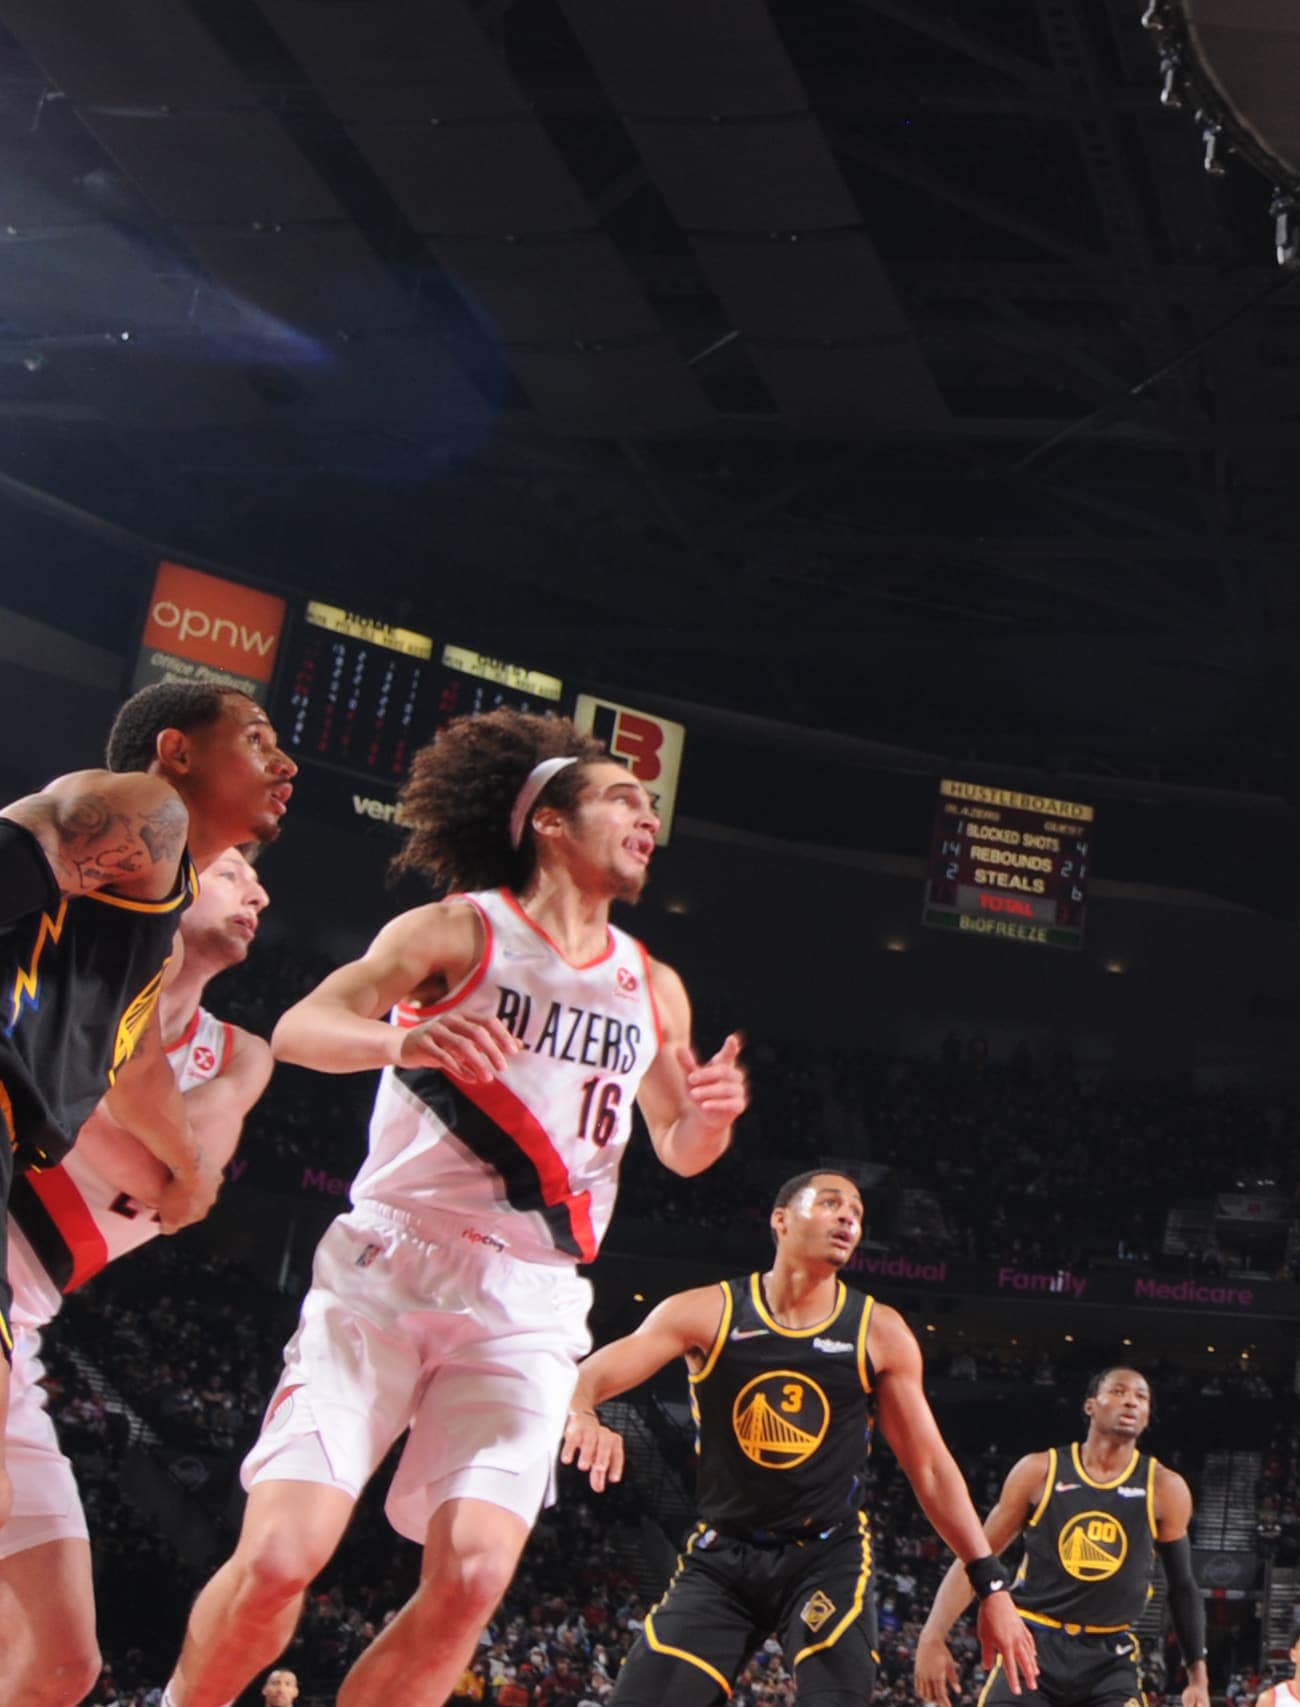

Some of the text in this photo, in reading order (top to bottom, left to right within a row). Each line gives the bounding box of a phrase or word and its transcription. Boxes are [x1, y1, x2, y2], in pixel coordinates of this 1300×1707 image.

[153, 600, 275, 656] opnw
[950, 781, 1084, 818] HUSTLEBOARD
[966, 822, 1060, 853] BLOCKED SHOTS
[970, 845, 1053, 873] REBOUNDS
[974, 868, 1046, 894] STEALS
[979, 892, 1035, 918] TOTAL
[496, 985, 641, 1075] BLAZERS
[577, 1075, 622, 1149] 16
[998, 1263, 1089, 1298] Family
[1133, 1277, 1254, 1306] Medicare
[781, 1383, 804, 1413] 3
[1087, 1520, 1117, 1544] 00
